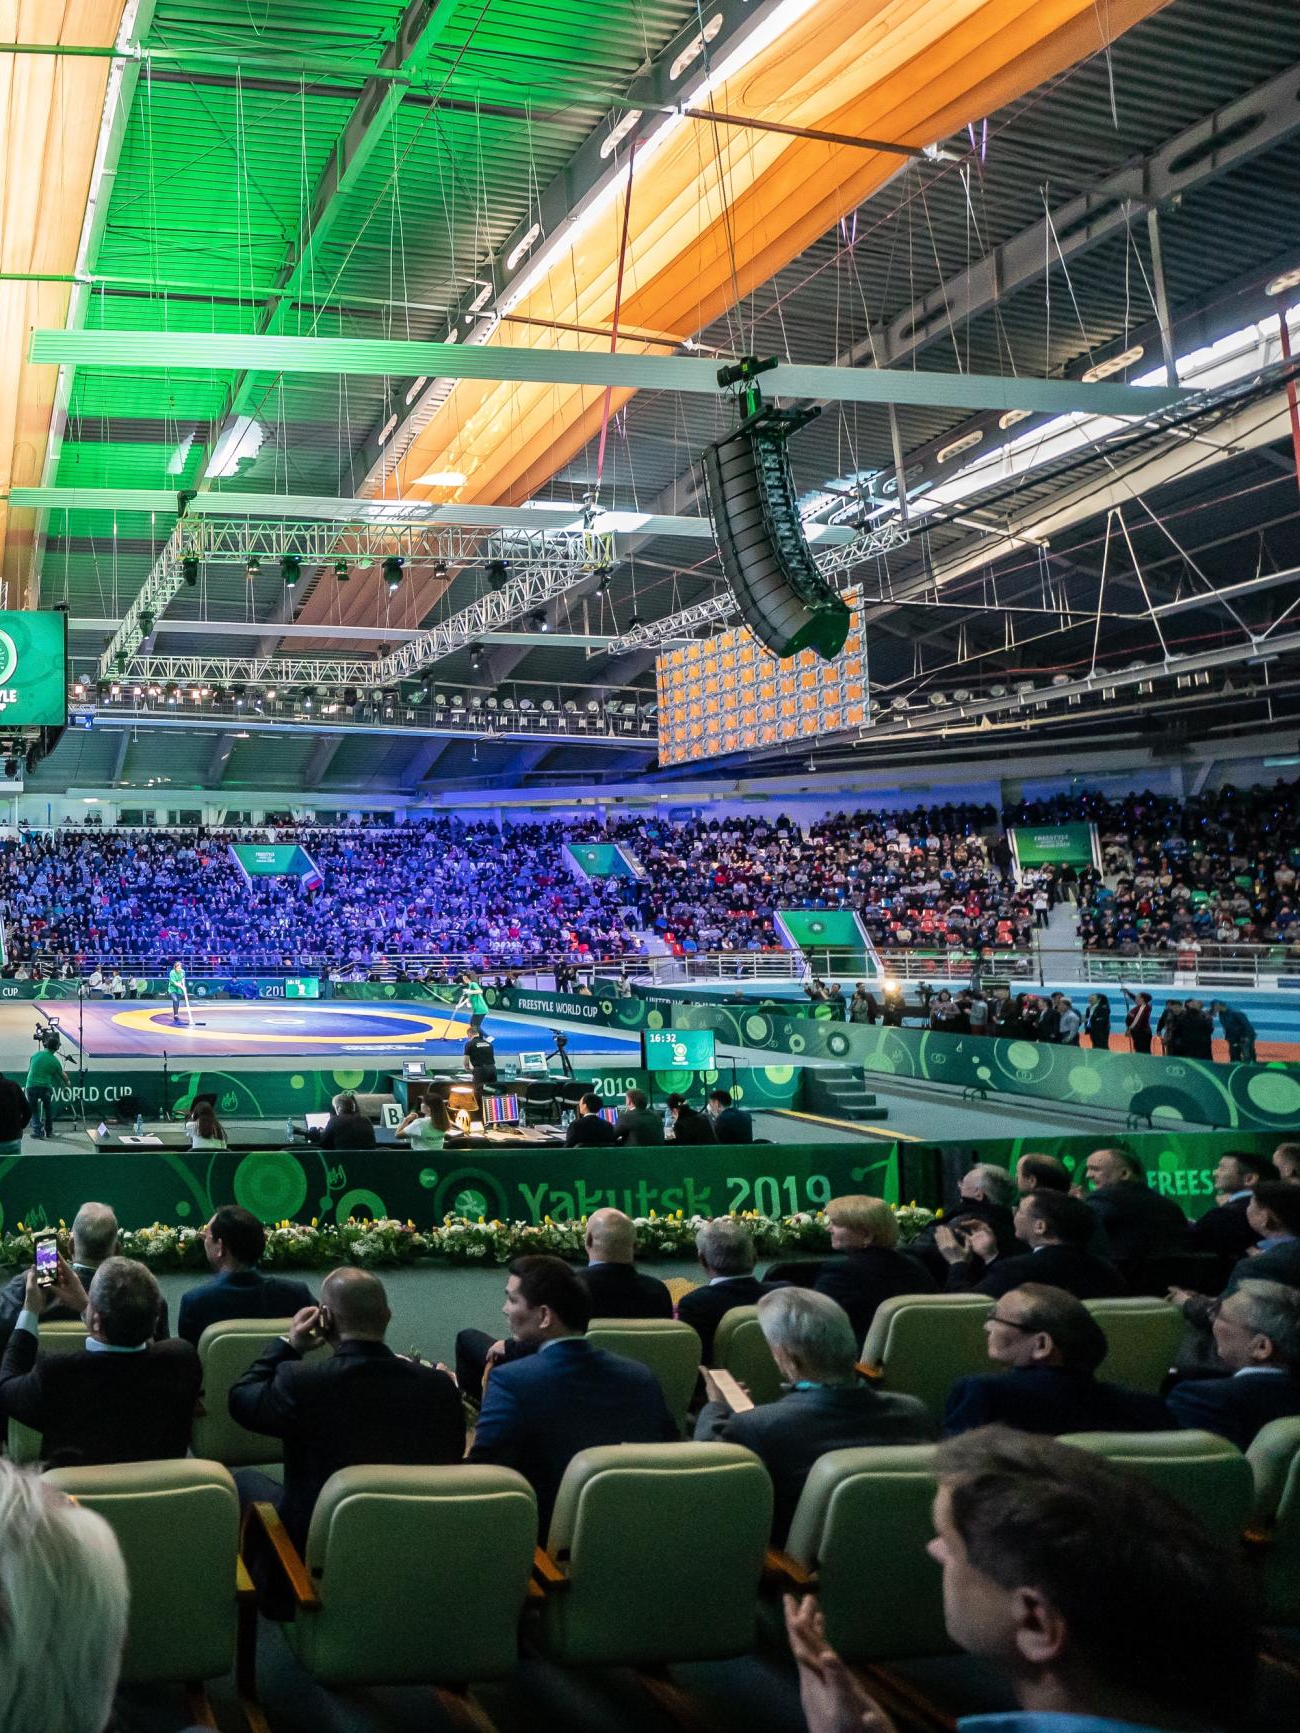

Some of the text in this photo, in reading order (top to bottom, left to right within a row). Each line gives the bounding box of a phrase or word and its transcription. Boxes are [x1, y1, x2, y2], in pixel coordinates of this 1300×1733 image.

[2, 988, 18, 996] CUP
[266, 985, 285, 997] 201
[518, 998, 598, 1018] FREESTYLE WORLD CUP
[649, 1033, 677, 1043] 16:32
[592, 1077, 637, 1097] 2019
[388, 1108, 400, 1125] B
[1147, 1169, 1216, 1195] FREES
[518, 1177, 713, 1225] Yakutsk
